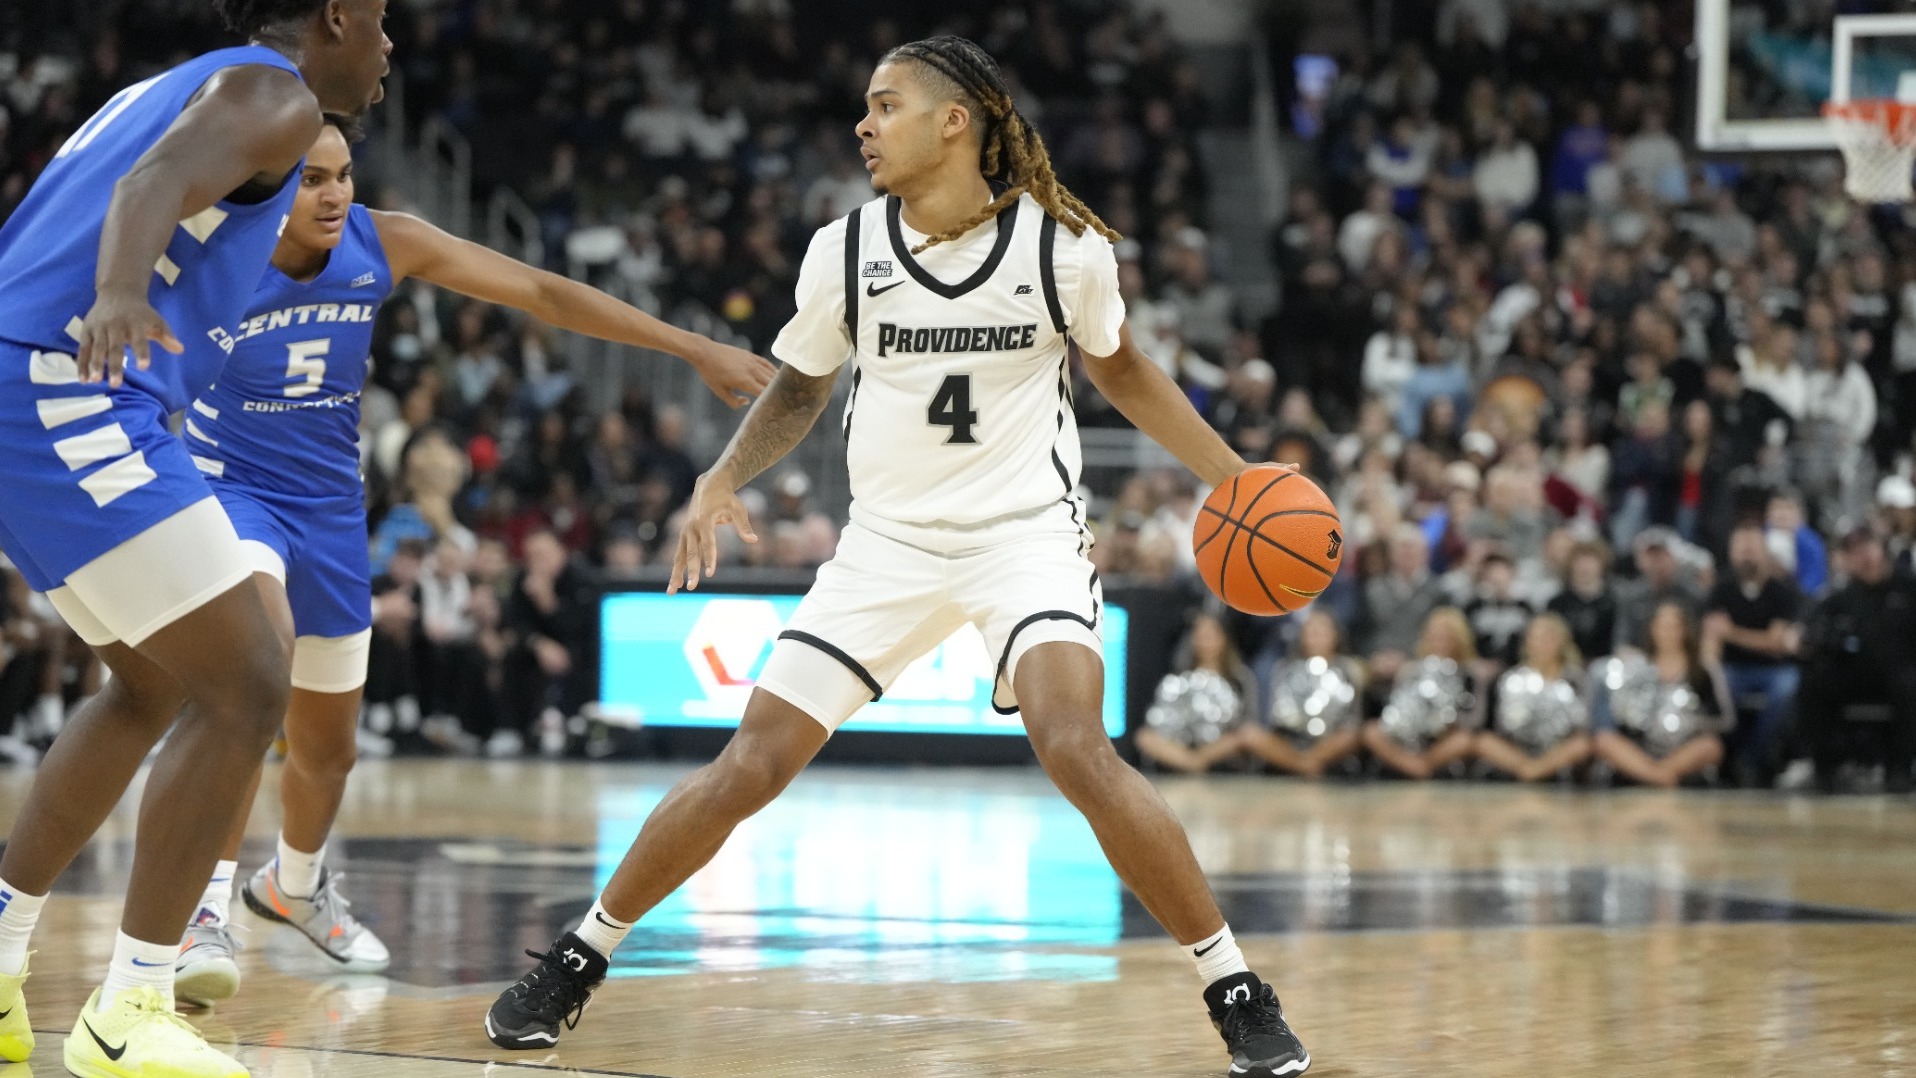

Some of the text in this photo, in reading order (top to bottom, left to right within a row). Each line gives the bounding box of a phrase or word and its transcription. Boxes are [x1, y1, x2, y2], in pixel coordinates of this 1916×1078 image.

[862, 269, 892, 277] CHANGE
[866, 261, 891, 270] BE THE
[207, 326, 235, 355] CO
[234, 303, 373, 343] CENTRAL
[877, 322, 1038, 357] PROVIDENCE
[283, 338, 331, 397] 5
[926, 371, 982, 446] 4
